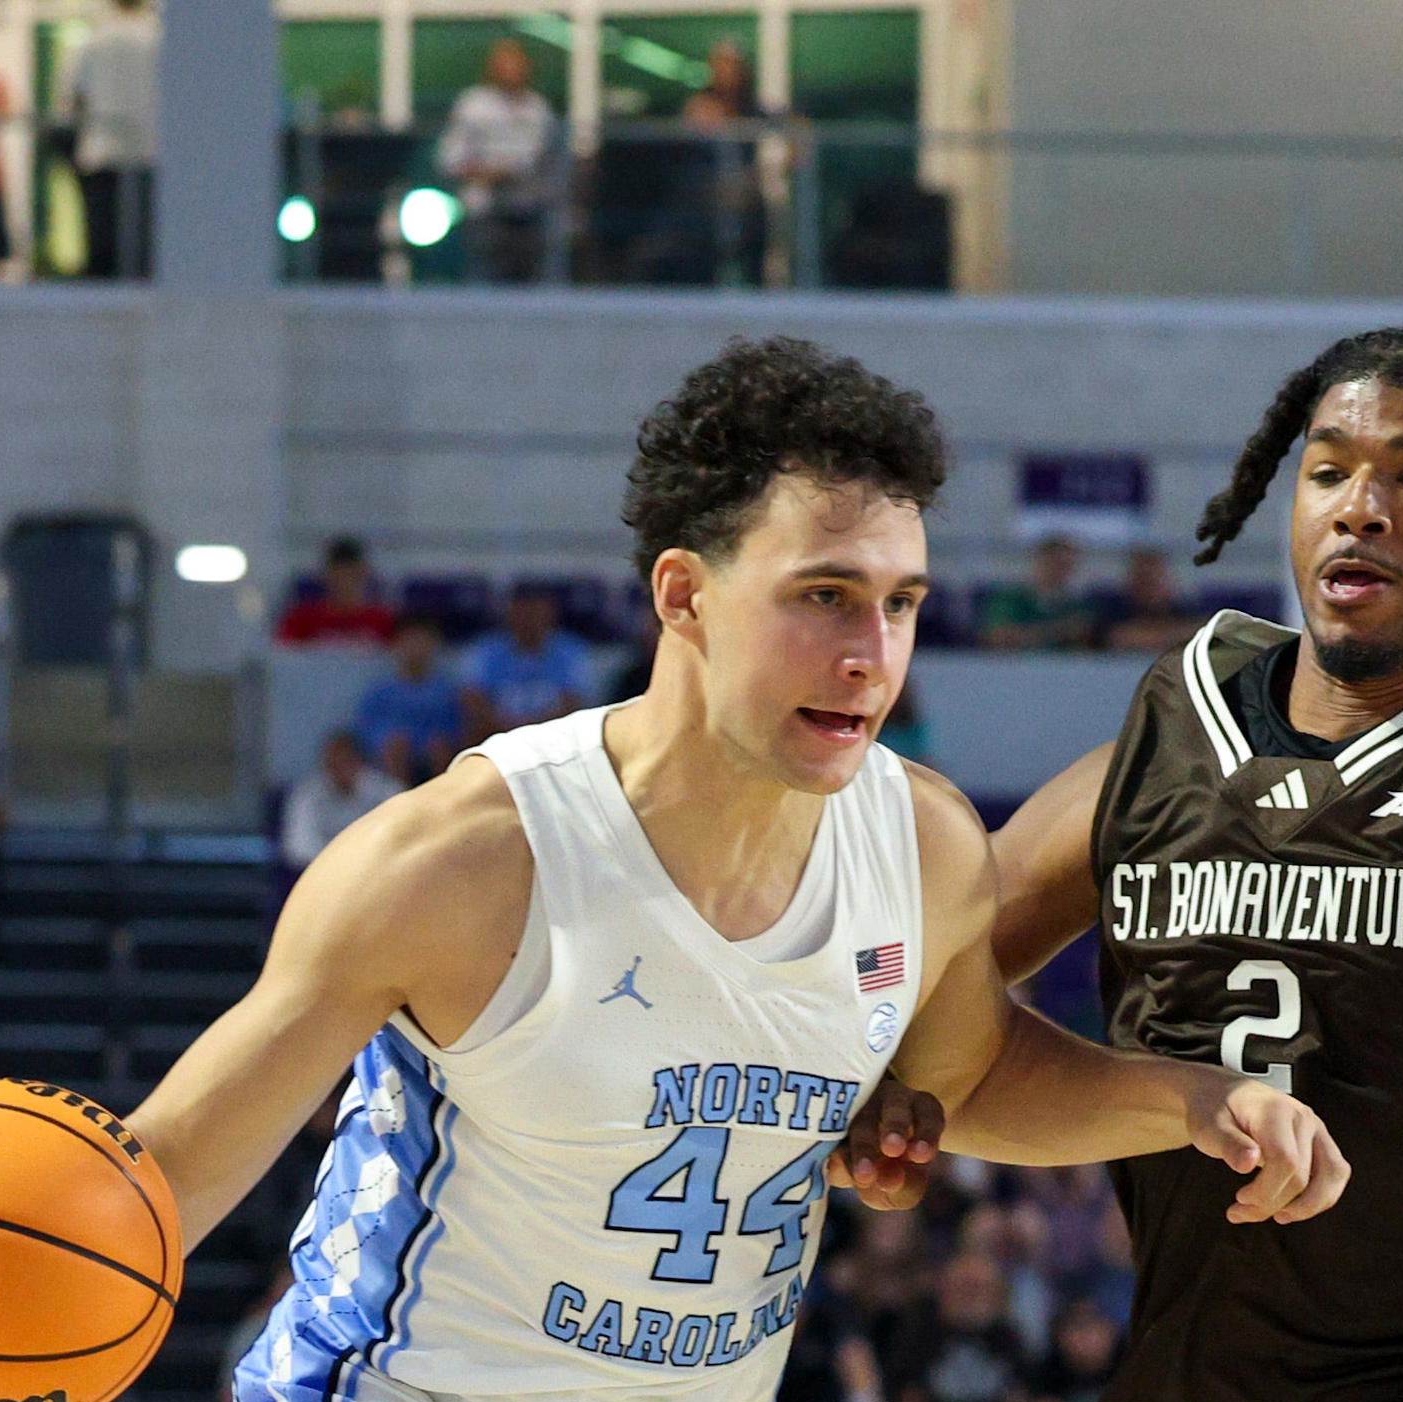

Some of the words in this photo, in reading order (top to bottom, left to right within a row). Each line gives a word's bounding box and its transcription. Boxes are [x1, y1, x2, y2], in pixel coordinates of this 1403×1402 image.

[1112, 862, 1158, 940] ST.
[1220, 959, 1301, 1094] 2
[645, 1062, 860, 1133] NORTH
[604, 1126, 836, 1285] 44
